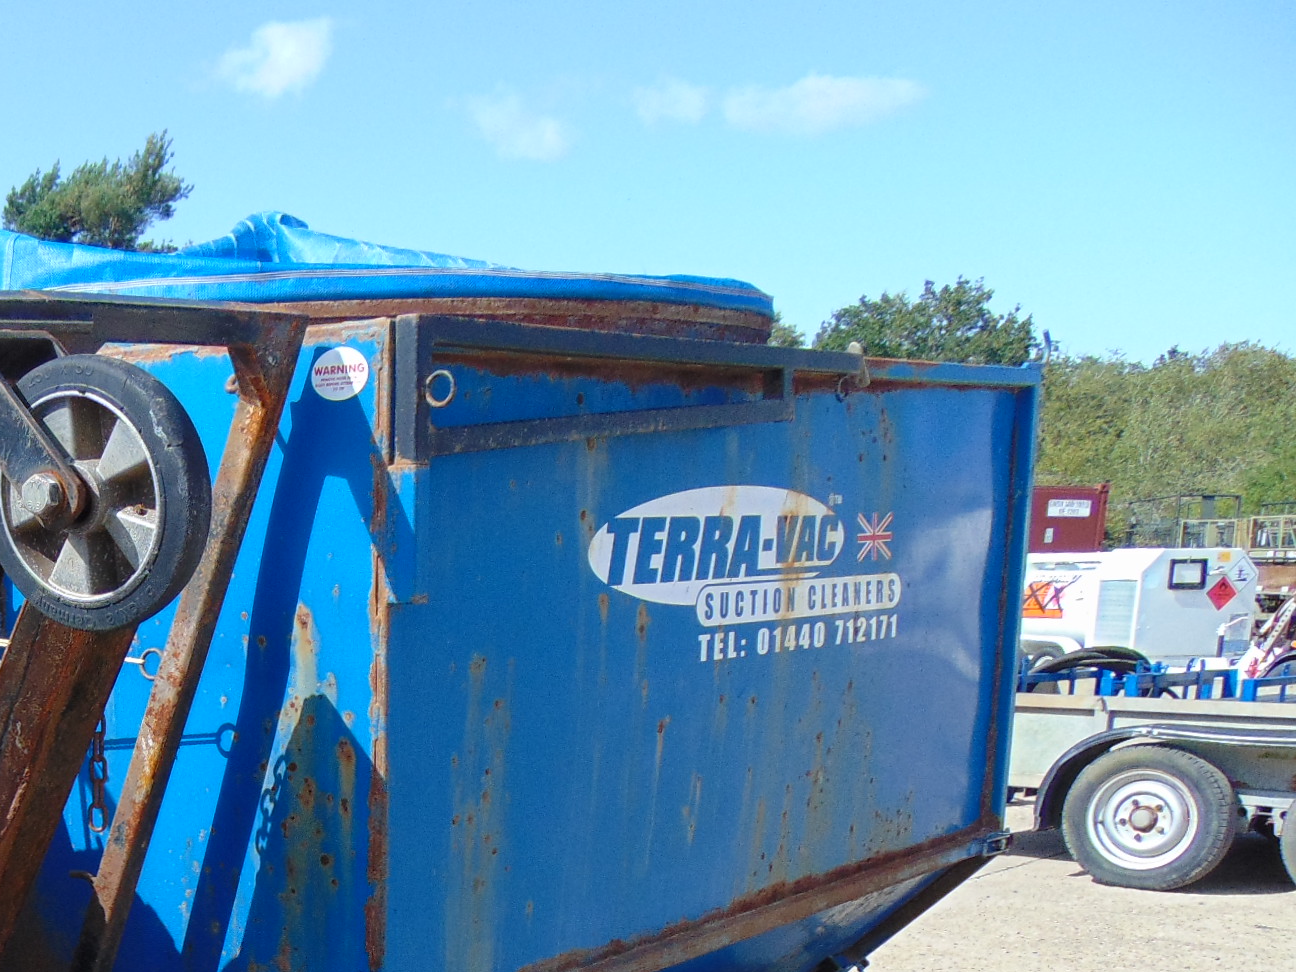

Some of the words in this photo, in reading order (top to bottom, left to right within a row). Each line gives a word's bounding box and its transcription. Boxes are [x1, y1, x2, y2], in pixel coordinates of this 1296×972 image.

[314, 362, 365, 376] WARNING
[606, 514, 839, 586] TERRA-VAC
[704, 587, 795, 620] SUCTION
[807, 578, 896, 610] CLEANERS
[698, 633, 747, 661] TEL:
[756, 623, 826, 655] 01440
[834, 614, 898, 645] 712171
